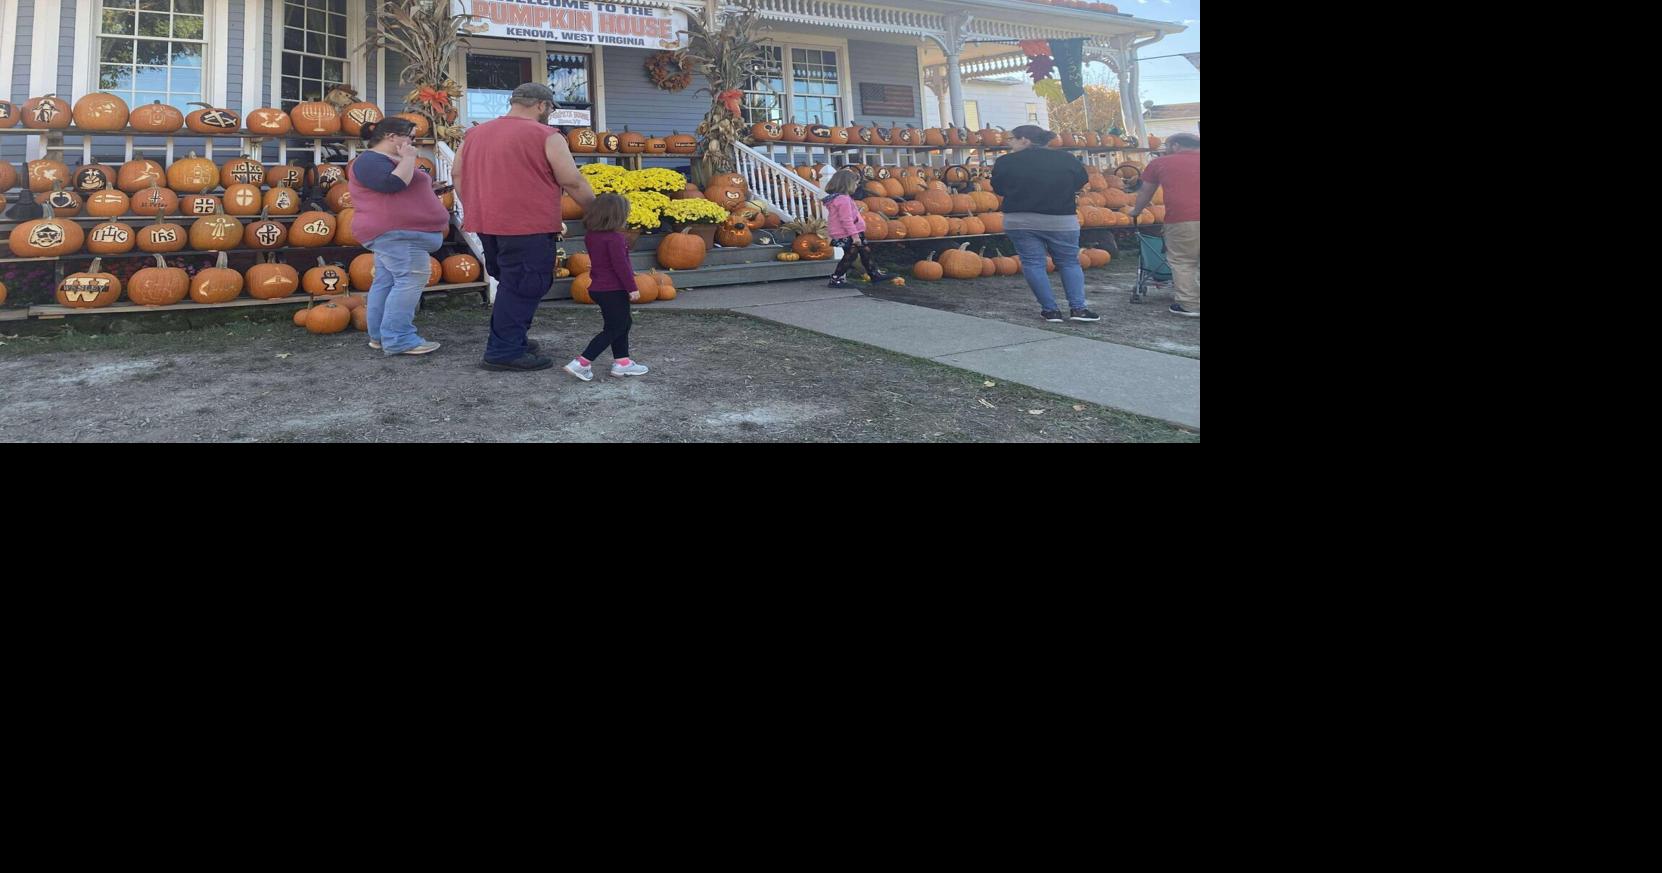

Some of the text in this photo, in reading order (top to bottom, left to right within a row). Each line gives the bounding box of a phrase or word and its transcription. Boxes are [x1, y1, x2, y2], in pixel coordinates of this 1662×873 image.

[505, 0, 653, 16] LCOME TO THE
[472, 0, 672, 39] PUMPKIN HOUSE
[506, 27, 645, 46] KENOVA, WEST VIRGINIA
